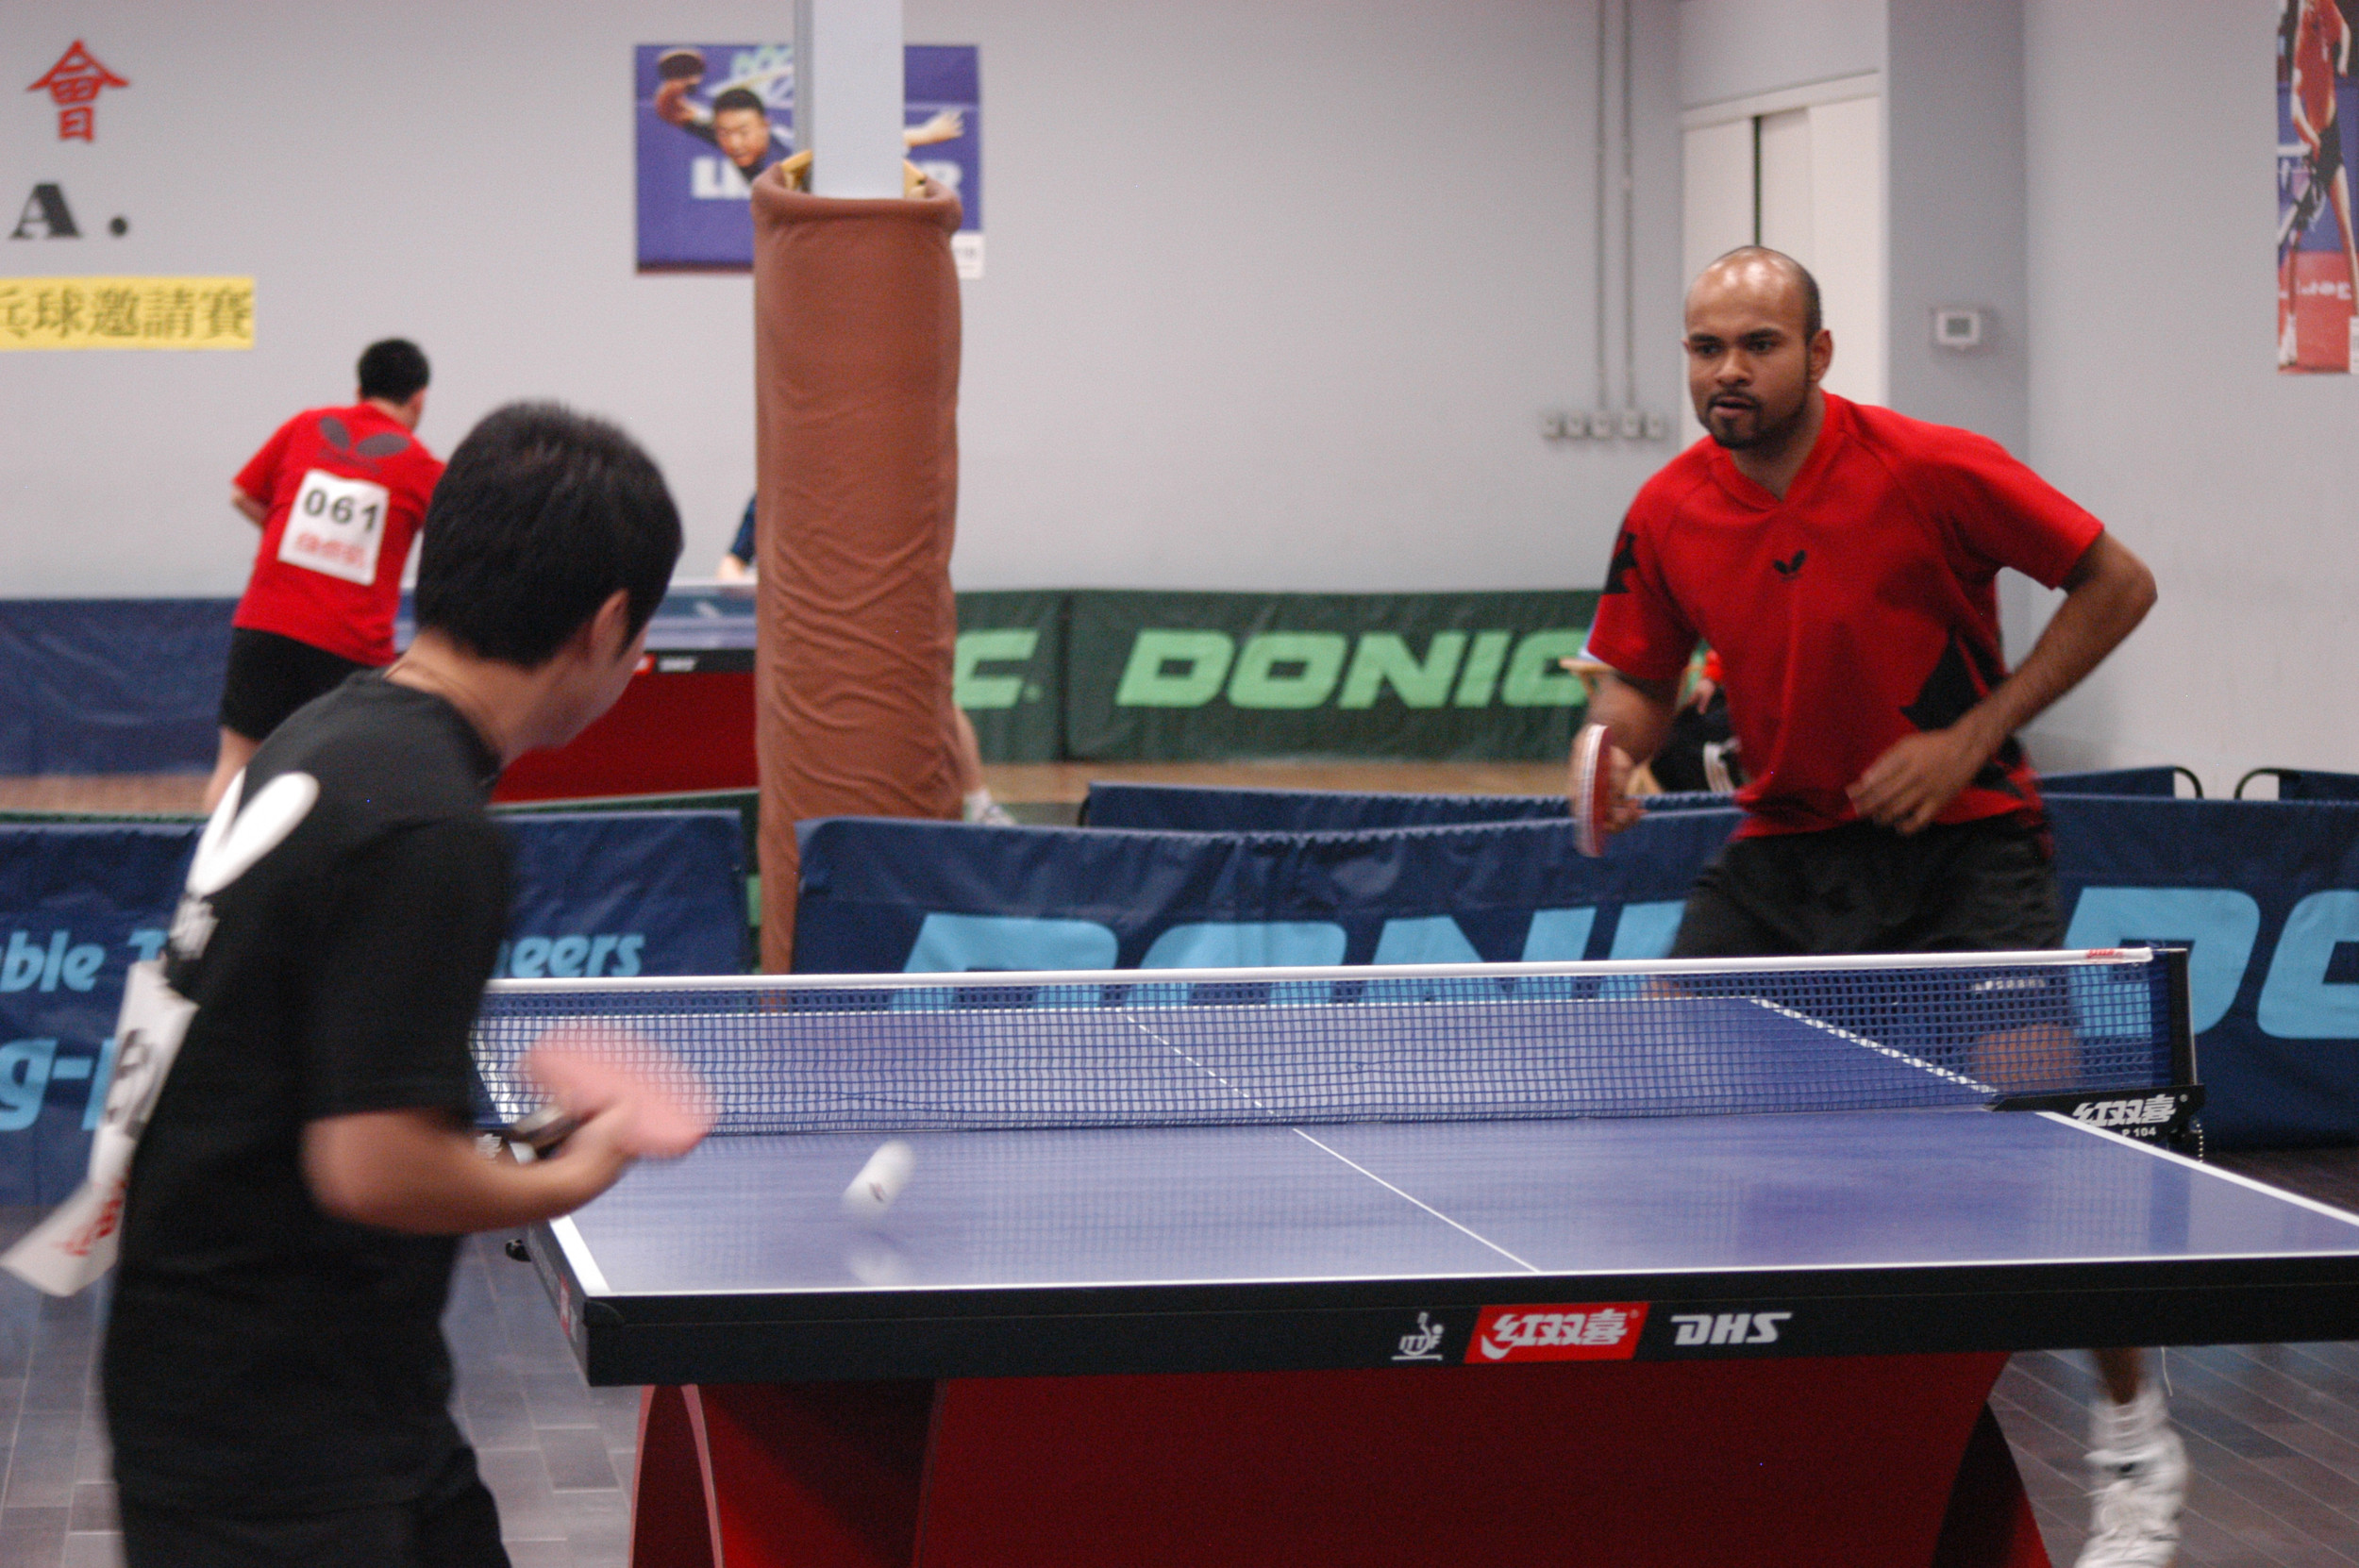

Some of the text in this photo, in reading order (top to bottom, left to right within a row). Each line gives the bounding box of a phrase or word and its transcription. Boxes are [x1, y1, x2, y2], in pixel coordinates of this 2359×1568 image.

[26, 38, 130, 142] 會
[302, 488, 379, 533] 061
[889, 900, 1687, 1011] DONI
[2072, 1094, 2176, 1127] 红双喜
[1481, 1309, 1628, 1359] 红双喜
[1670, 1311, 1792, 1345] DHS
